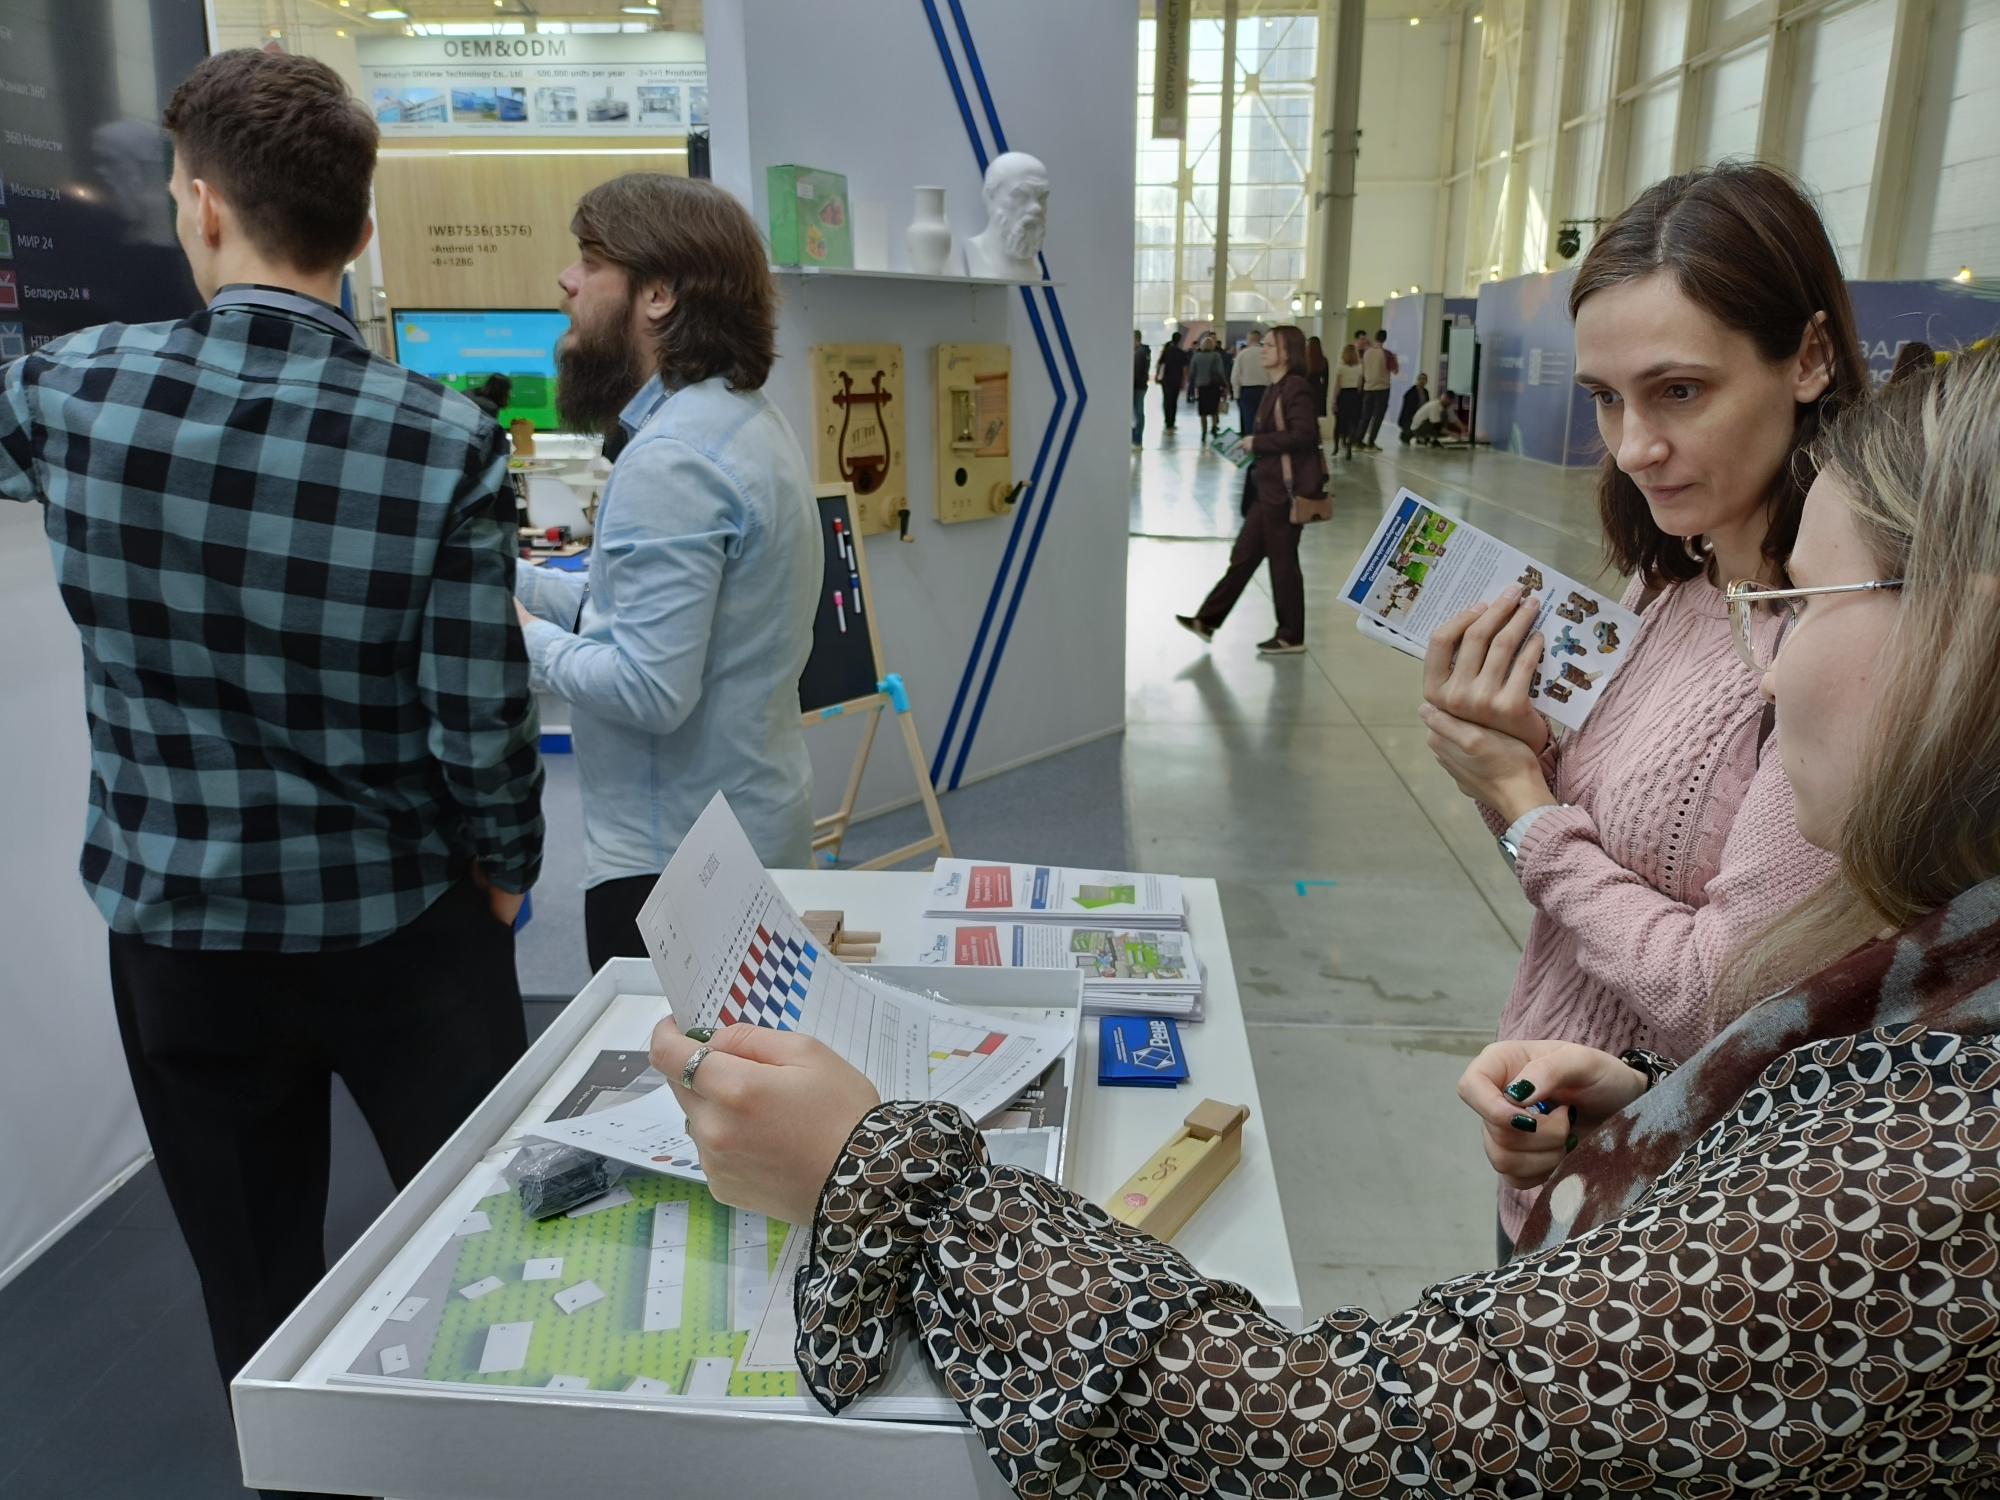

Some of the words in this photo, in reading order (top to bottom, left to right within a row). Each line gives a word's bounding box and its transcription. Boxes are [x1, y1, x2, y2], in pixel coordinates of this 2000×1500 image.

[444, 39, 567, 58] OEM&ODM
[17, 234, 40, 248] МИР
[42, 236, 54, 250] 24
[24, 285, 68, 301] Беларусь
[69, 287, 80, 300] 24
